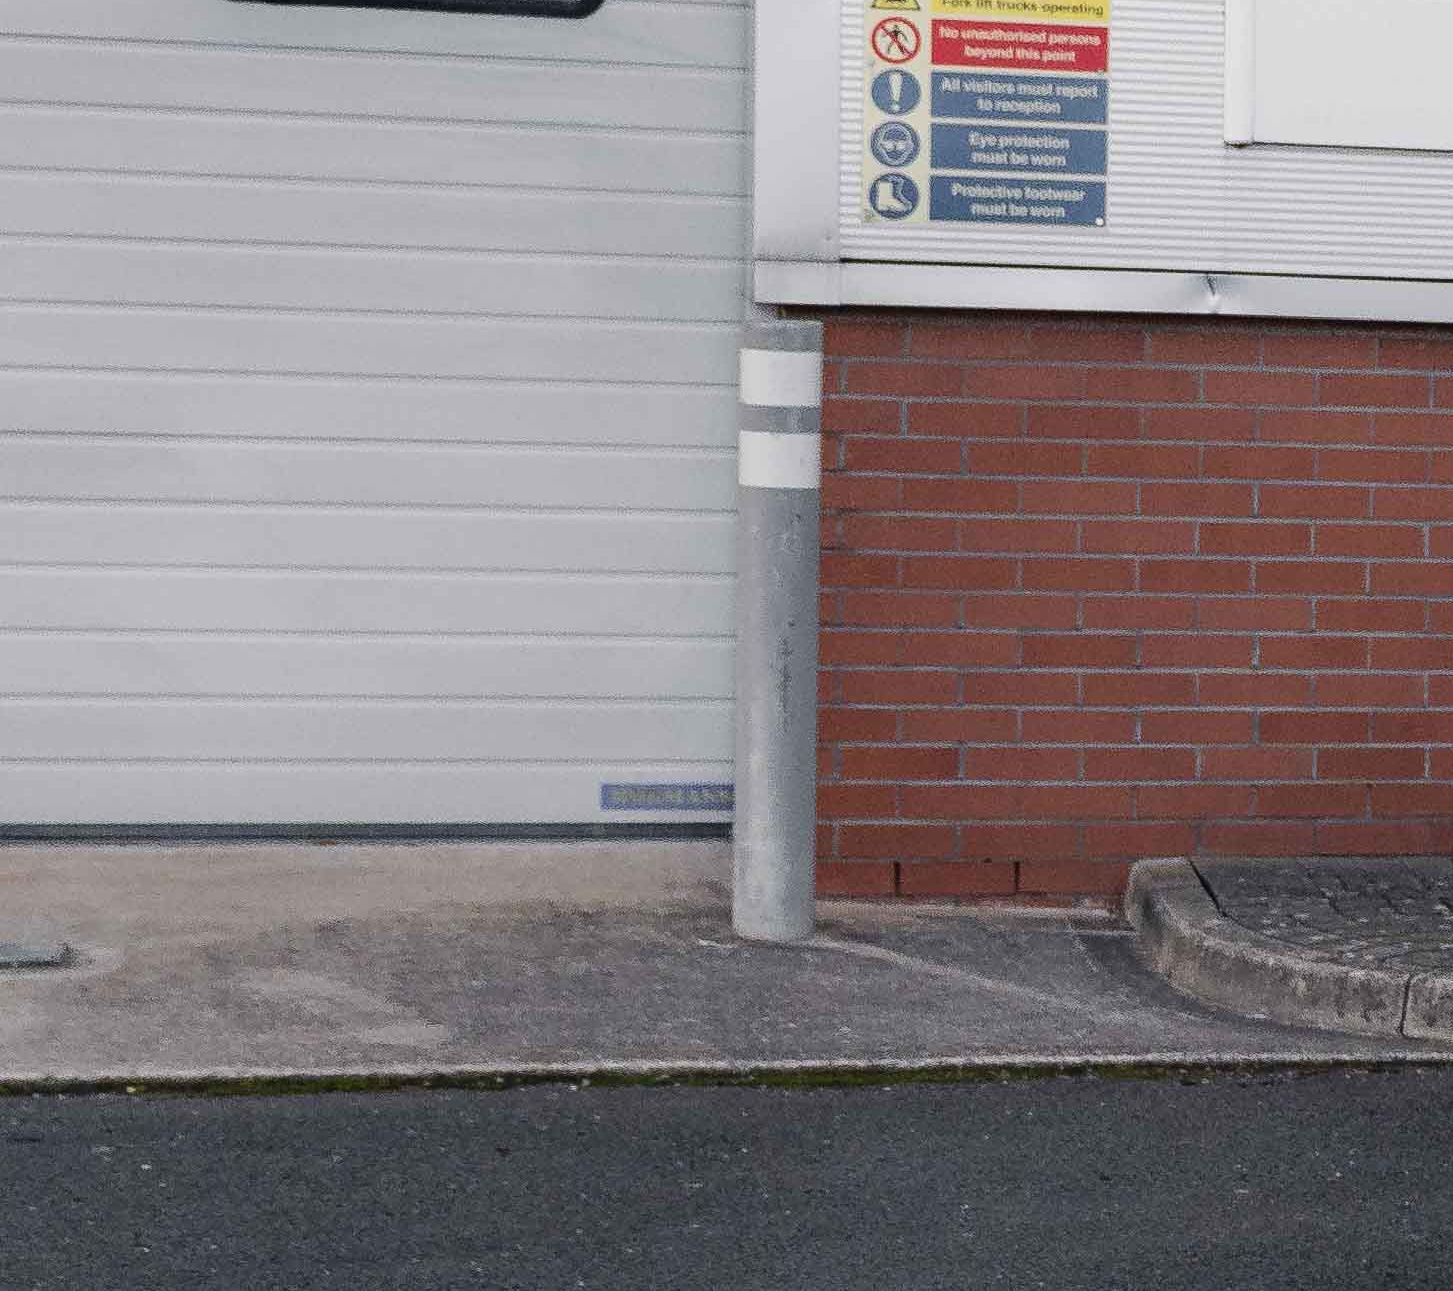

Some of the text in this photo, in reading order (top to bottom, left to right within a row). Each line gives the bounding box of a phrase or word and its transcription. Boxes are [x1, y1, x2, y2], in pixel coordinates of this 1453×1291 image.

[996, 0, 1037, 12] trucks
[1041, 2, 1104, 16] operating
[939, 26, 958, 39] No
[964, 45, 1076, 63] beyond this point
[941, 77, 961, 92] All
